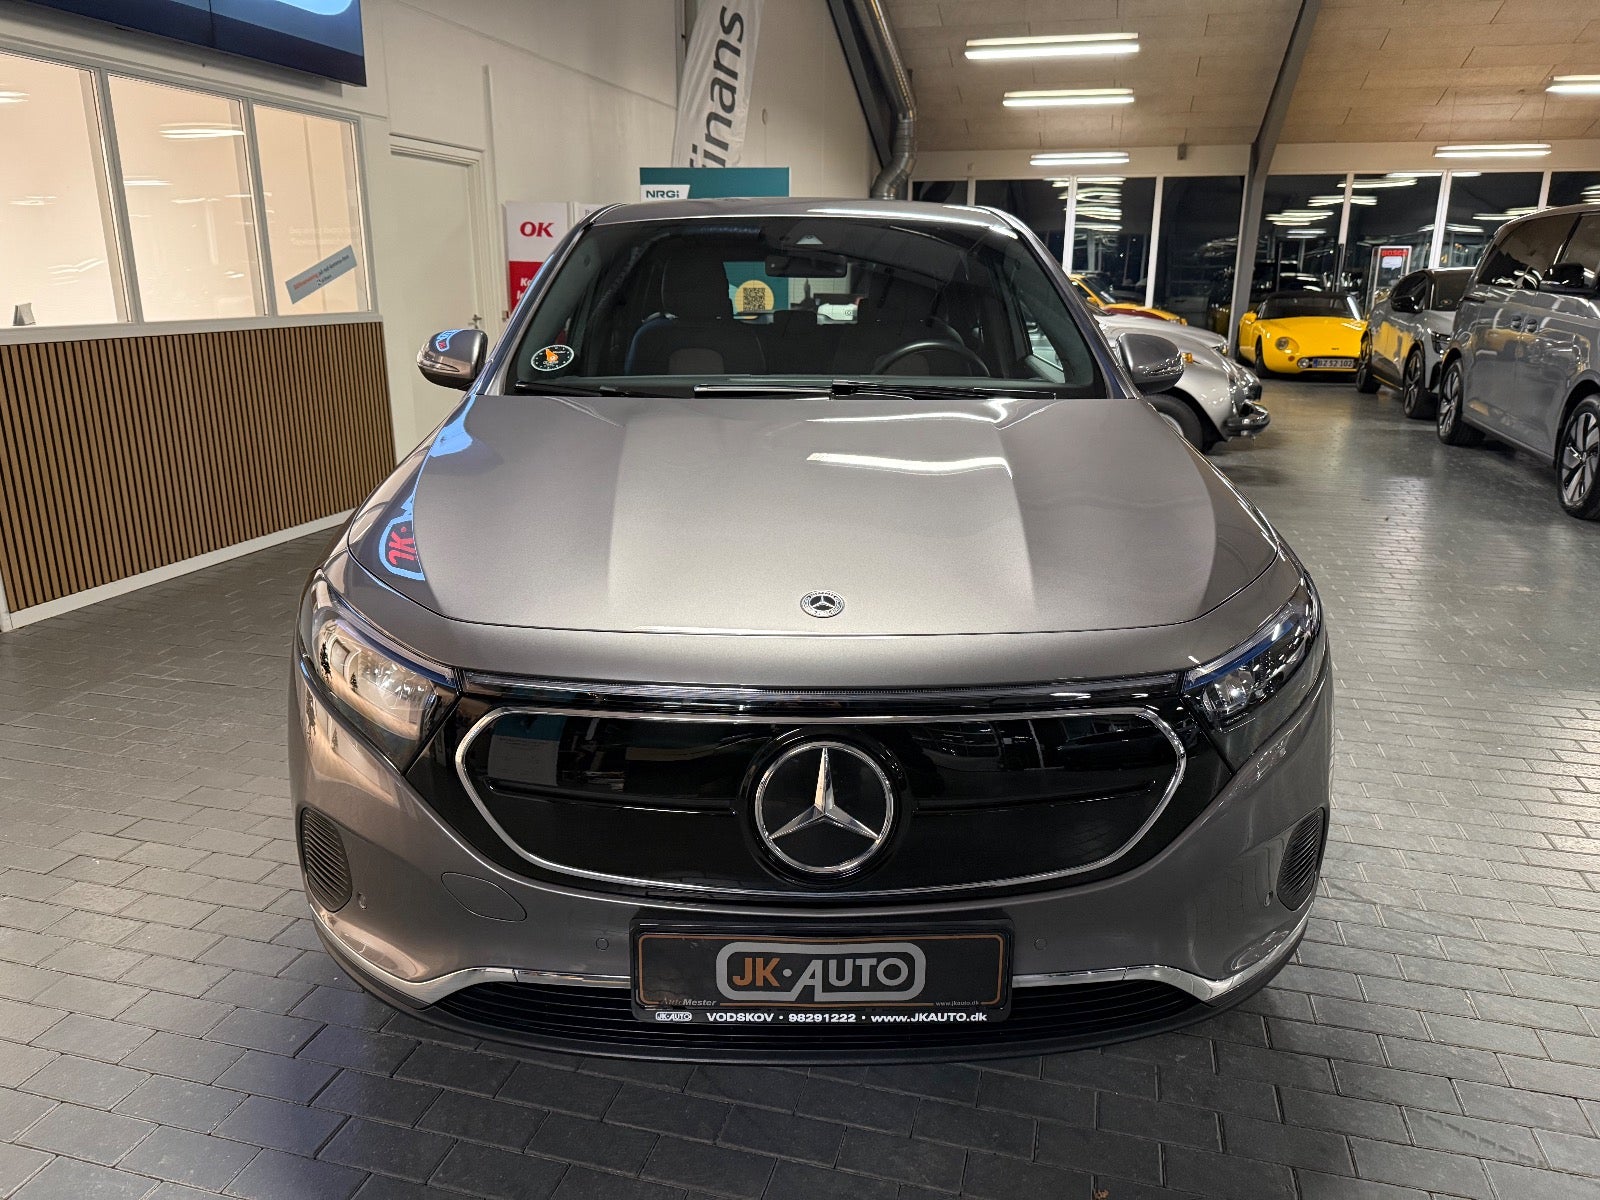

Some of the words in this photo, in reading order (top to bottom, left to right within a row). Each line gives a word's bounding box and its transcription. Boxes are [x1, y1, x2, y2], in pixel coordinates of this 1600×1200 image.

[645, 190, 680, 199] NRGi
[520, 221, 555, 238] OK
[706, 1012, 775, 1022] VODSKOV
[788, 1013, 857, 1023] 98291222
[870, 1012, 988, 1023] www.JKAUTO.dk
